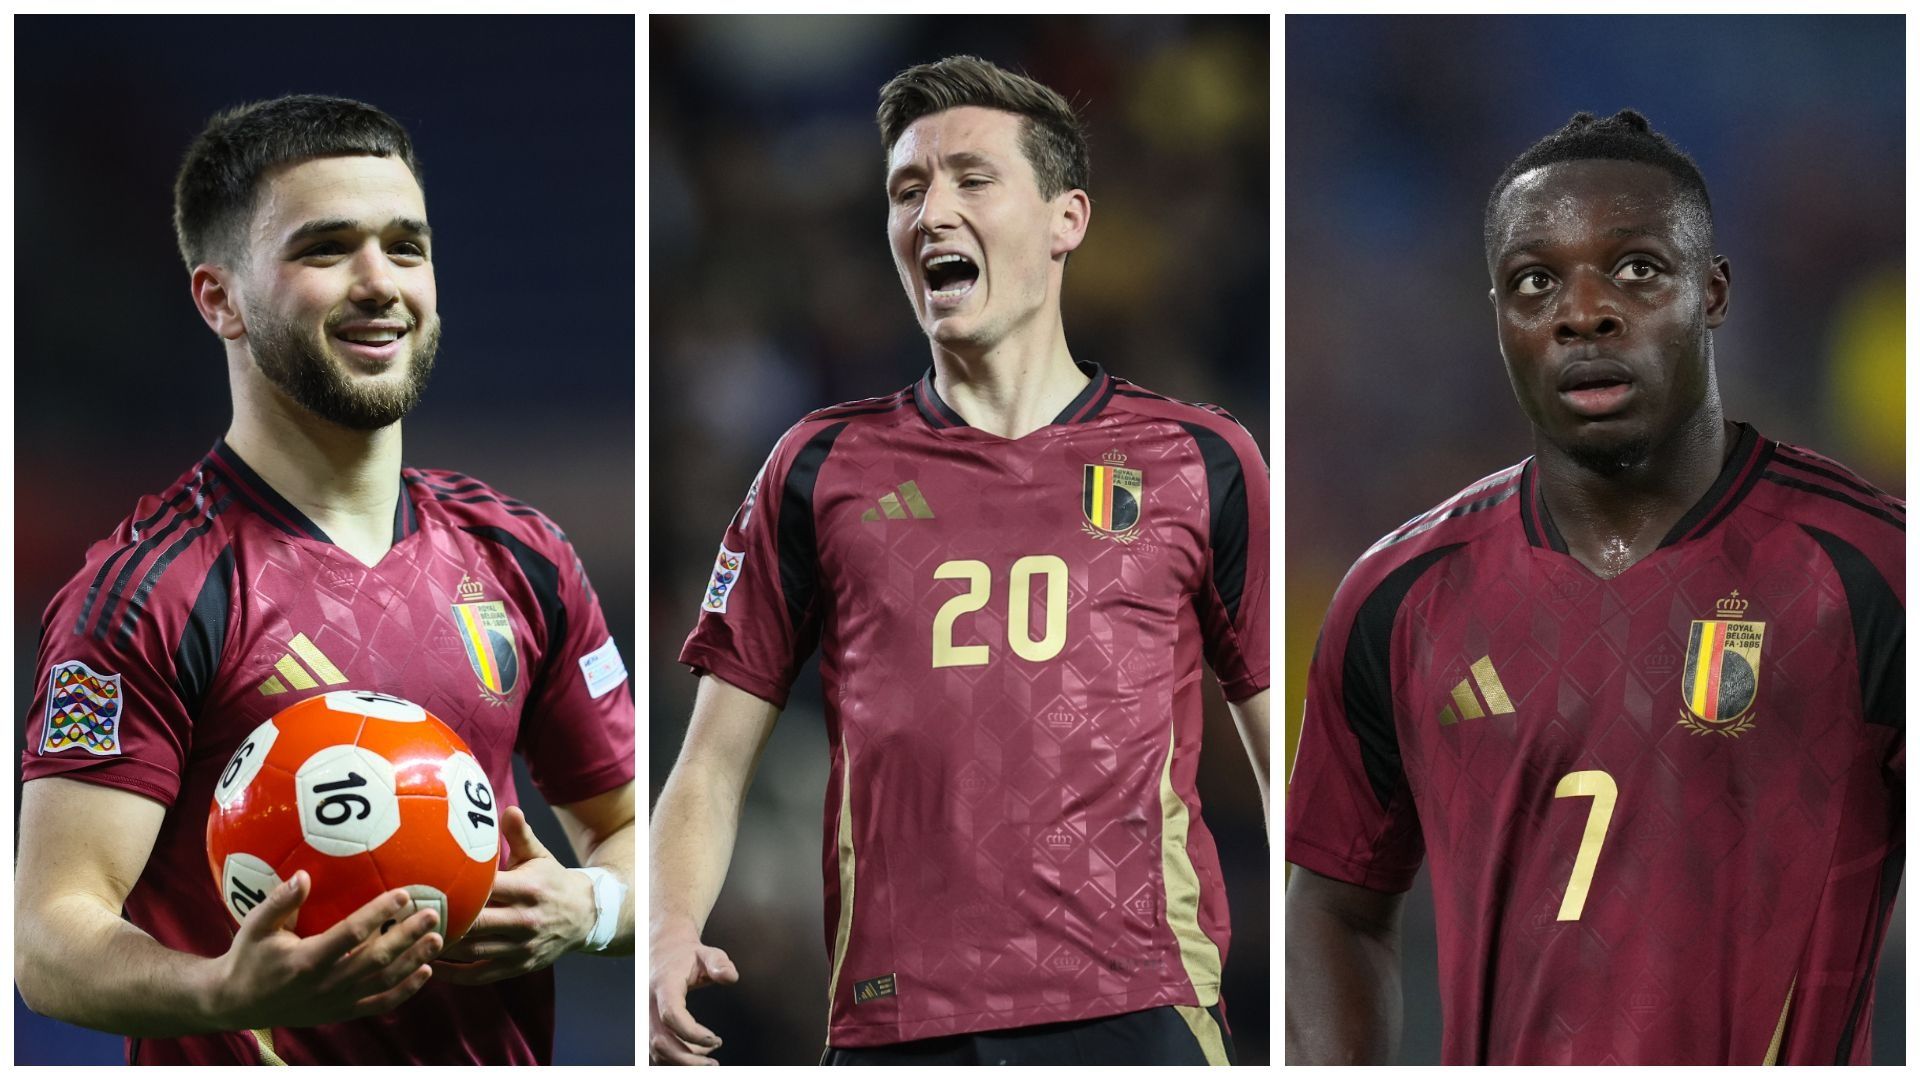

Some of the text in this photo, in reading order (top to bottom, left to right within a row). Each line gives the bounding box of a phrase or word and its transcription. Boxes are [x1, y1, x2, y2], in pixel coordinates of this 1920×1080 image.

[932, 554, 1069, 669] 20
[1726, 632, 1762, 640] BELGIAN
[1727, 623, 1753, 632] ROYAL
[312, 771, 371, 826] 16
[464, 780, 495, 830] 16
[1554, 769, 1619, 922] 7
